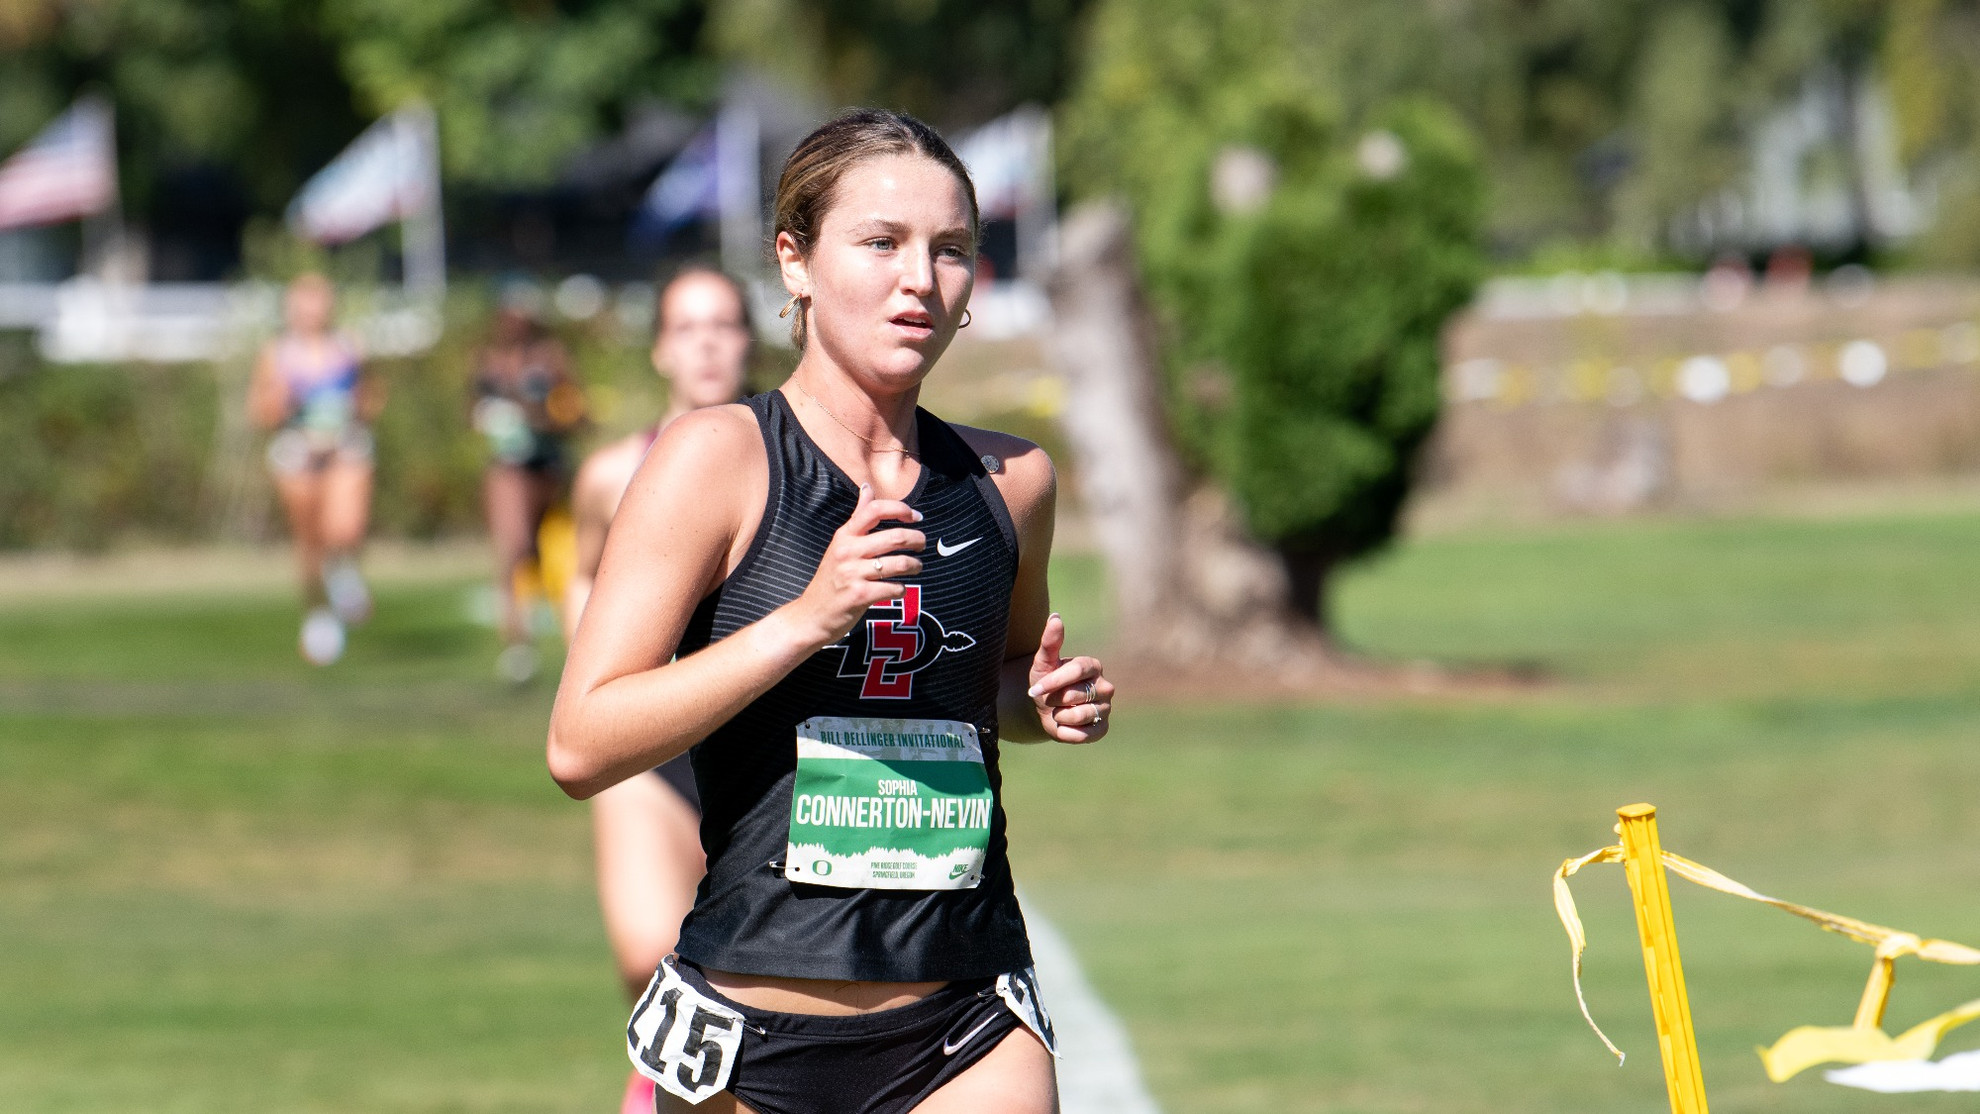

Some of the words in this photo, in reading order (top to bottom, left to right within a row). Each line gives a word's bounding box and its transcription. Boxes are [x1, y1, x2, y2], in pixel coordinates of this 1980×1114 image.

[820, 730, 842, 745] BILL
[844, 731, 896, 748] DELLINGER
[898, 732, 966, 749] INVITATIONAL
[878, 779, 918, 796] SOPHIA
[795, 794, 991, 829] CONNERTON-NEVIN
[952, 863, 969, 873] NIKE
